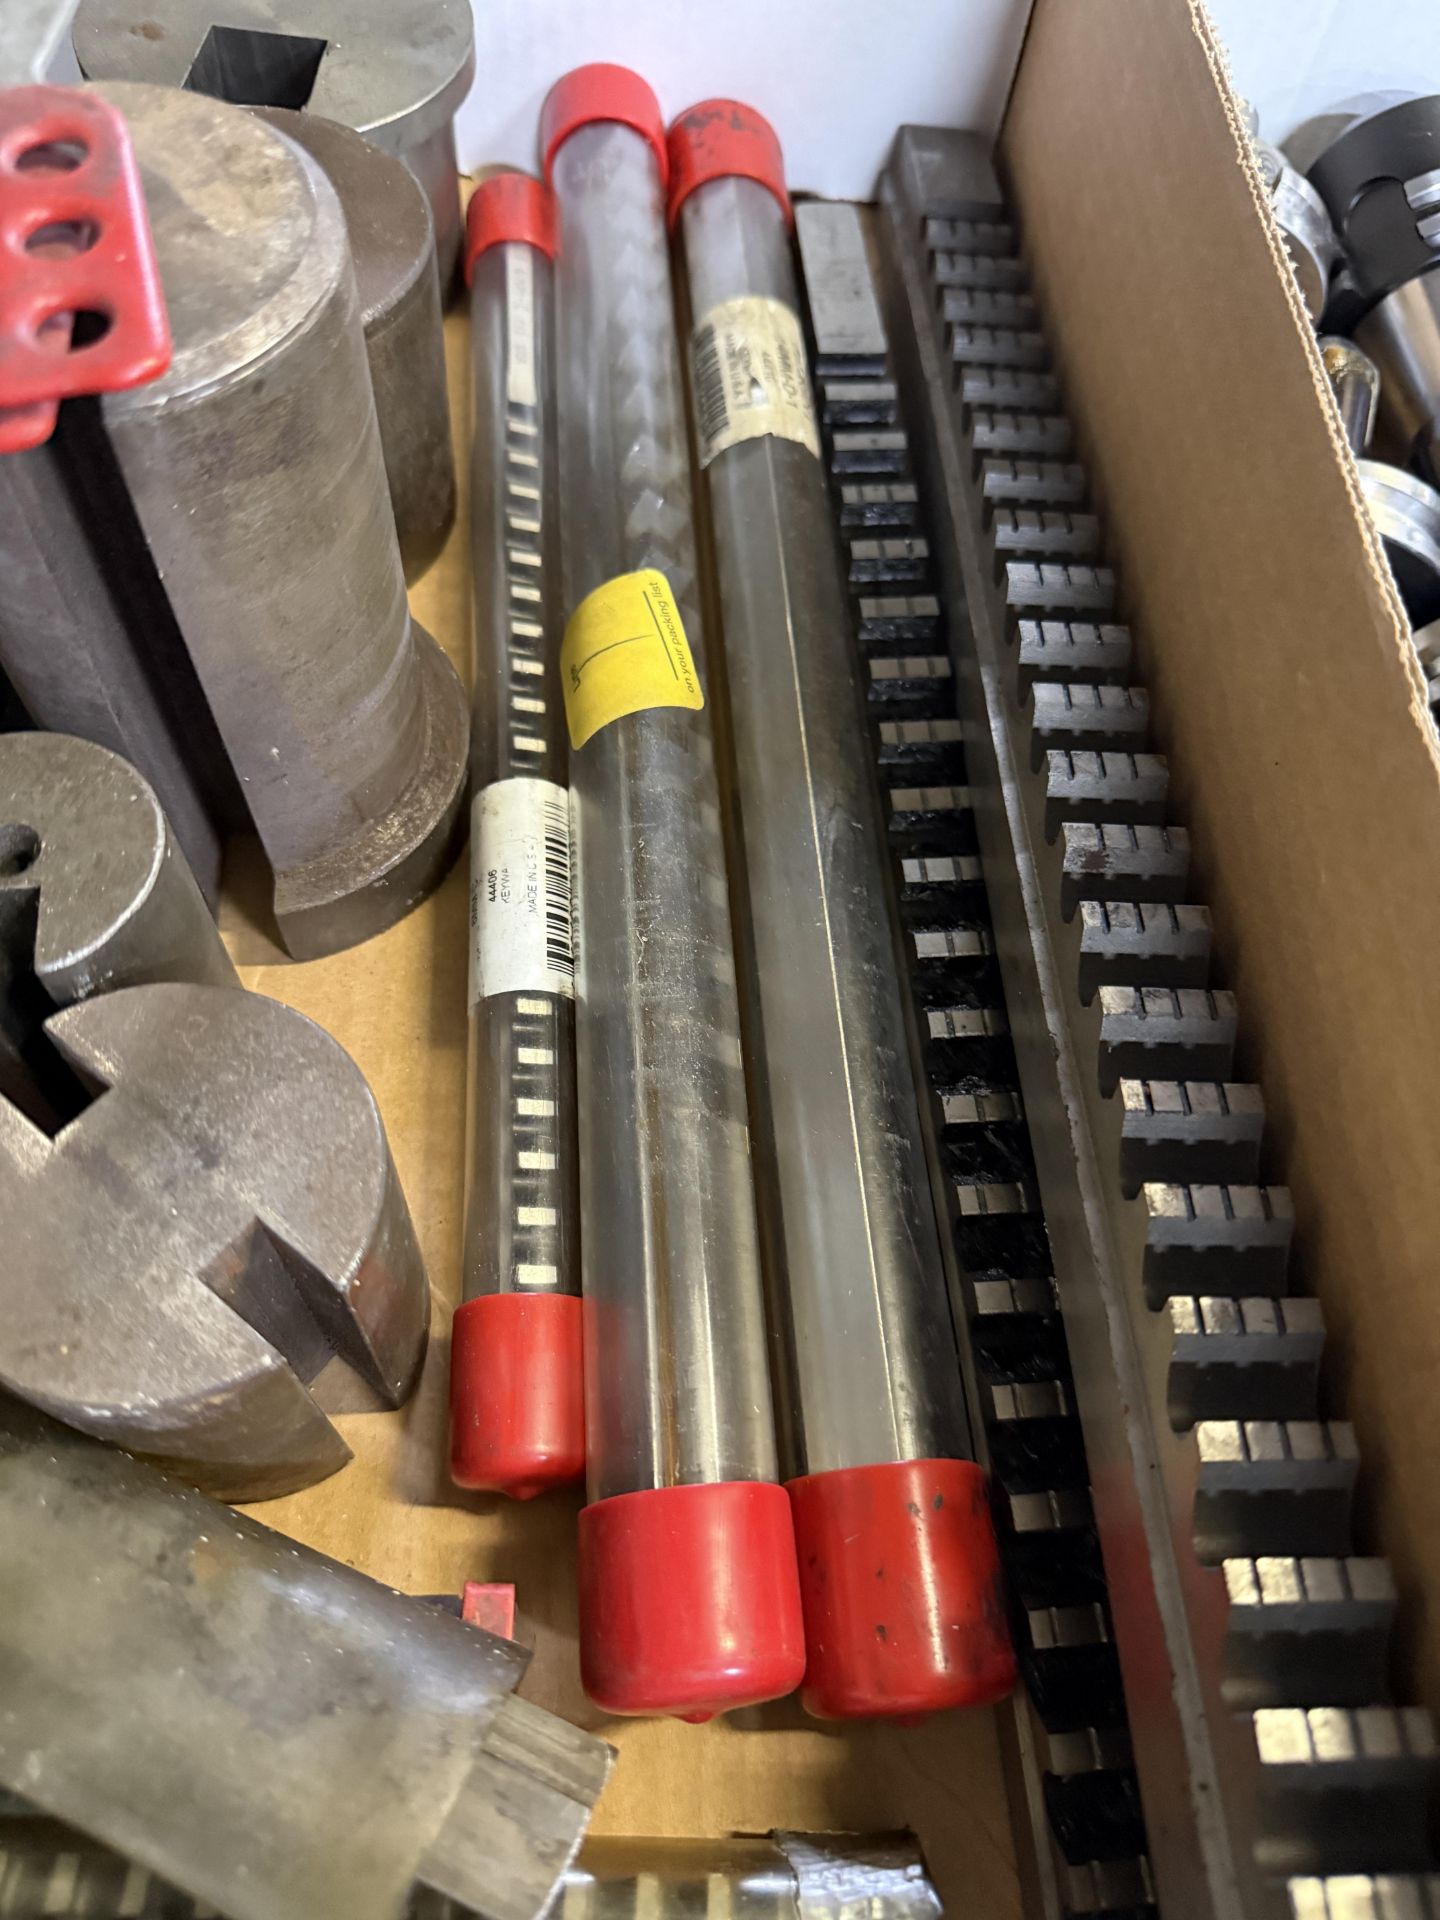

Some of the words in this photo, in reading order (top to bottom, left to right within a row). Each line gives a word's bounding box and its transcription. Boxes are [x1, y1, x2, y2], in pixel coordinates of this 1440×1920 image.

[650, 582, 662, 598] list
[660, 600, 680, 647] packing
[676, 649, 692, 676] your
[684, 678, 695, 693] on
[488, 869, 498, 903] 44406
[528, 871, 538, 882] IN
[528, 883, 538, 914] MADE
